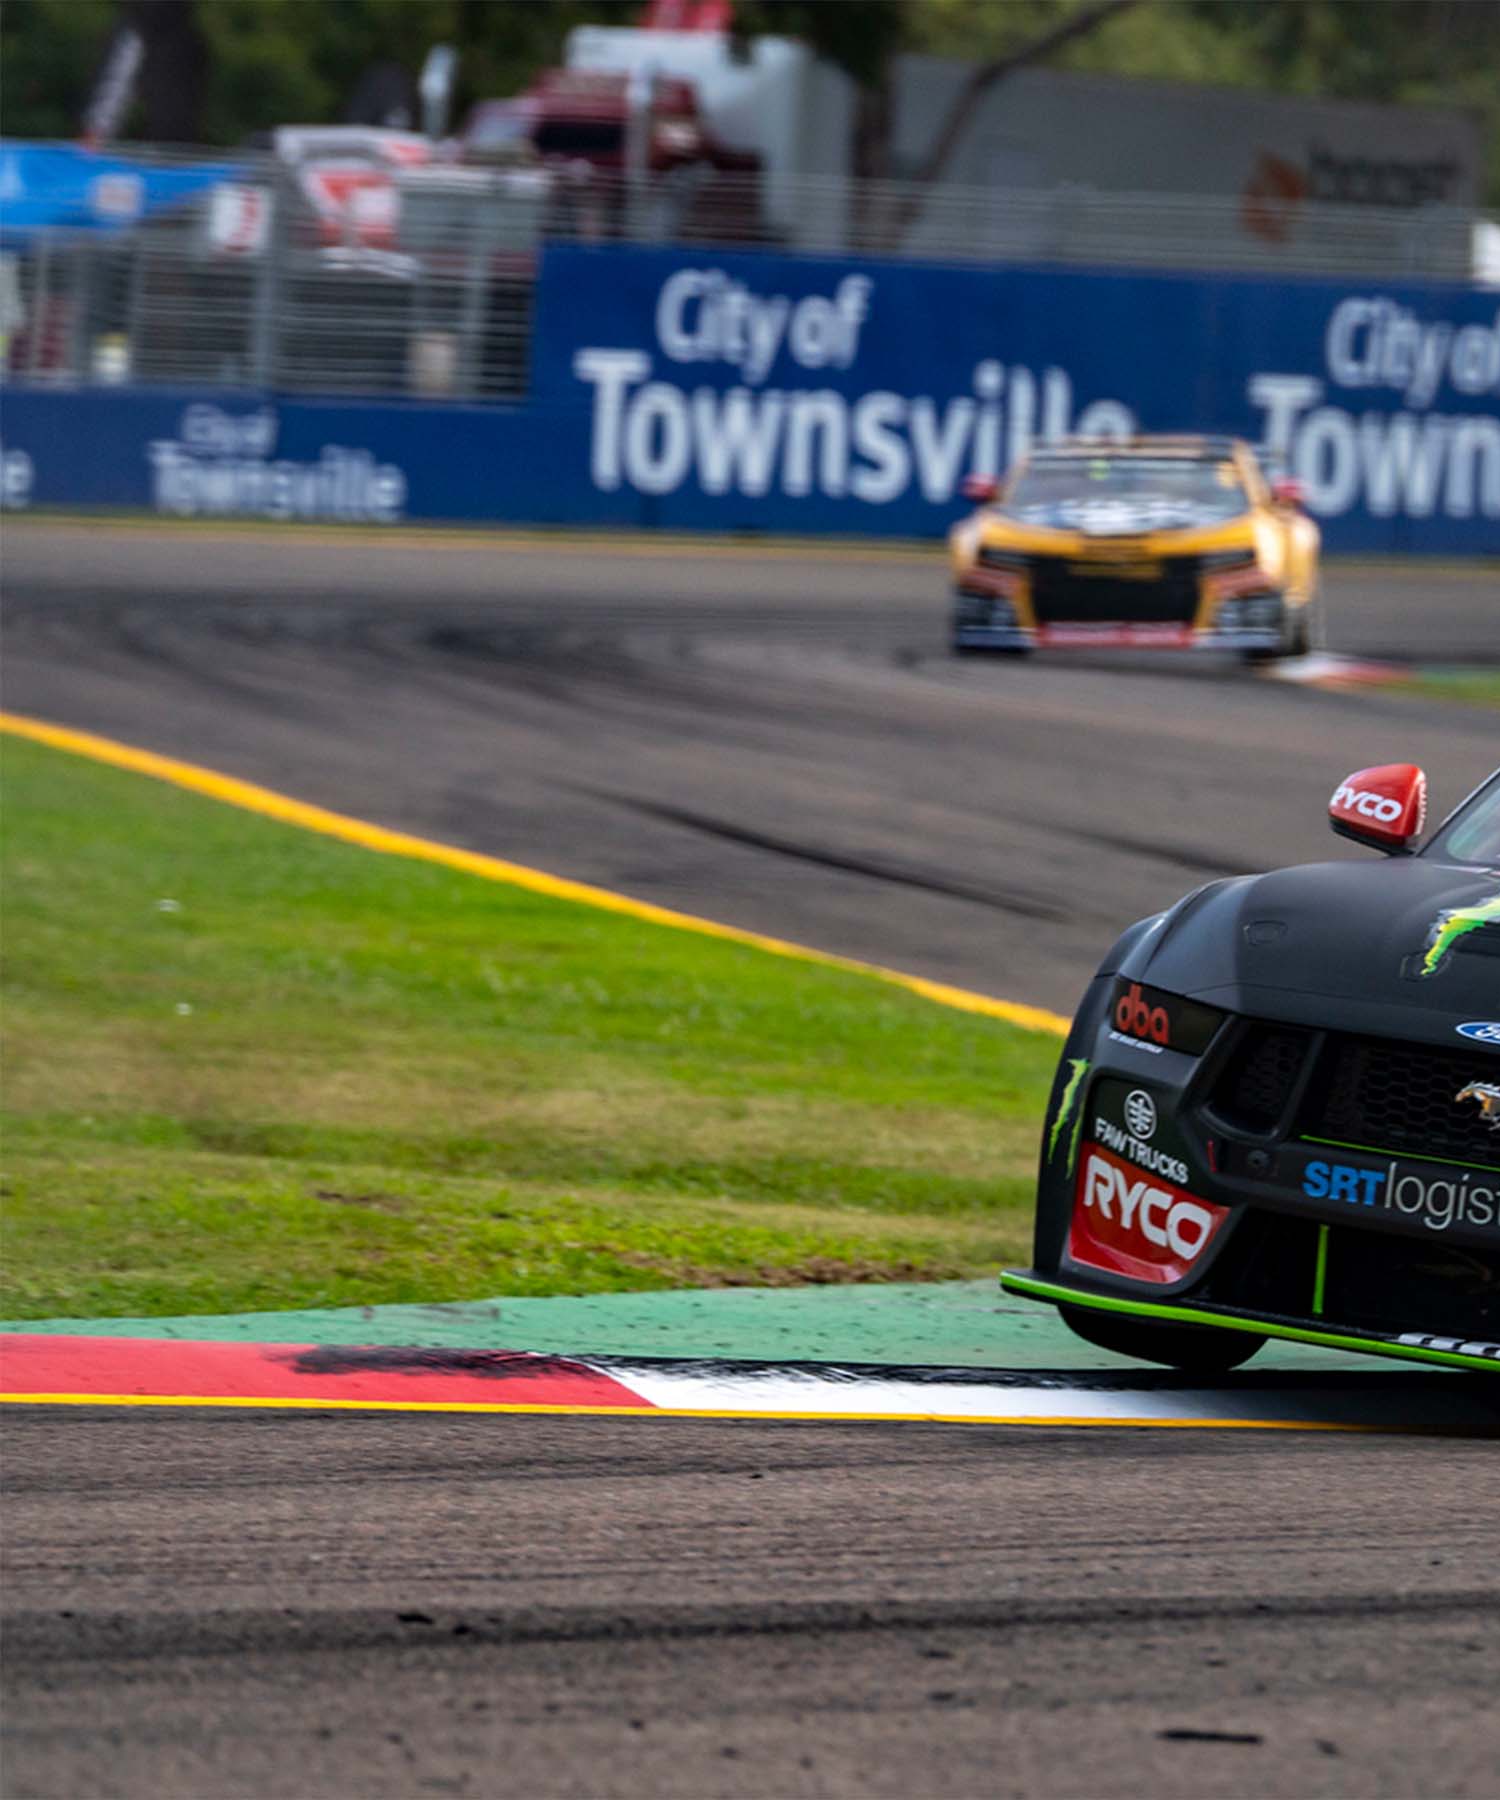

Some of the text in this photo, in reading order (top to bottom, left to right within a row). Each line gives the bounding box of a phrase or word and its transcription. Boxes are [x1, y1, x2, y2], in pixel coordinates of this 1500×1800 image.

[656, 267, 873, 384] City of
[1326, 296, 1453, 409] City
[1116, 984, 1169, 1045] dba
[1084, 1154, 1213, 1261] RYCO
[1126, 1134, 1189, 1185] TRUCKS
